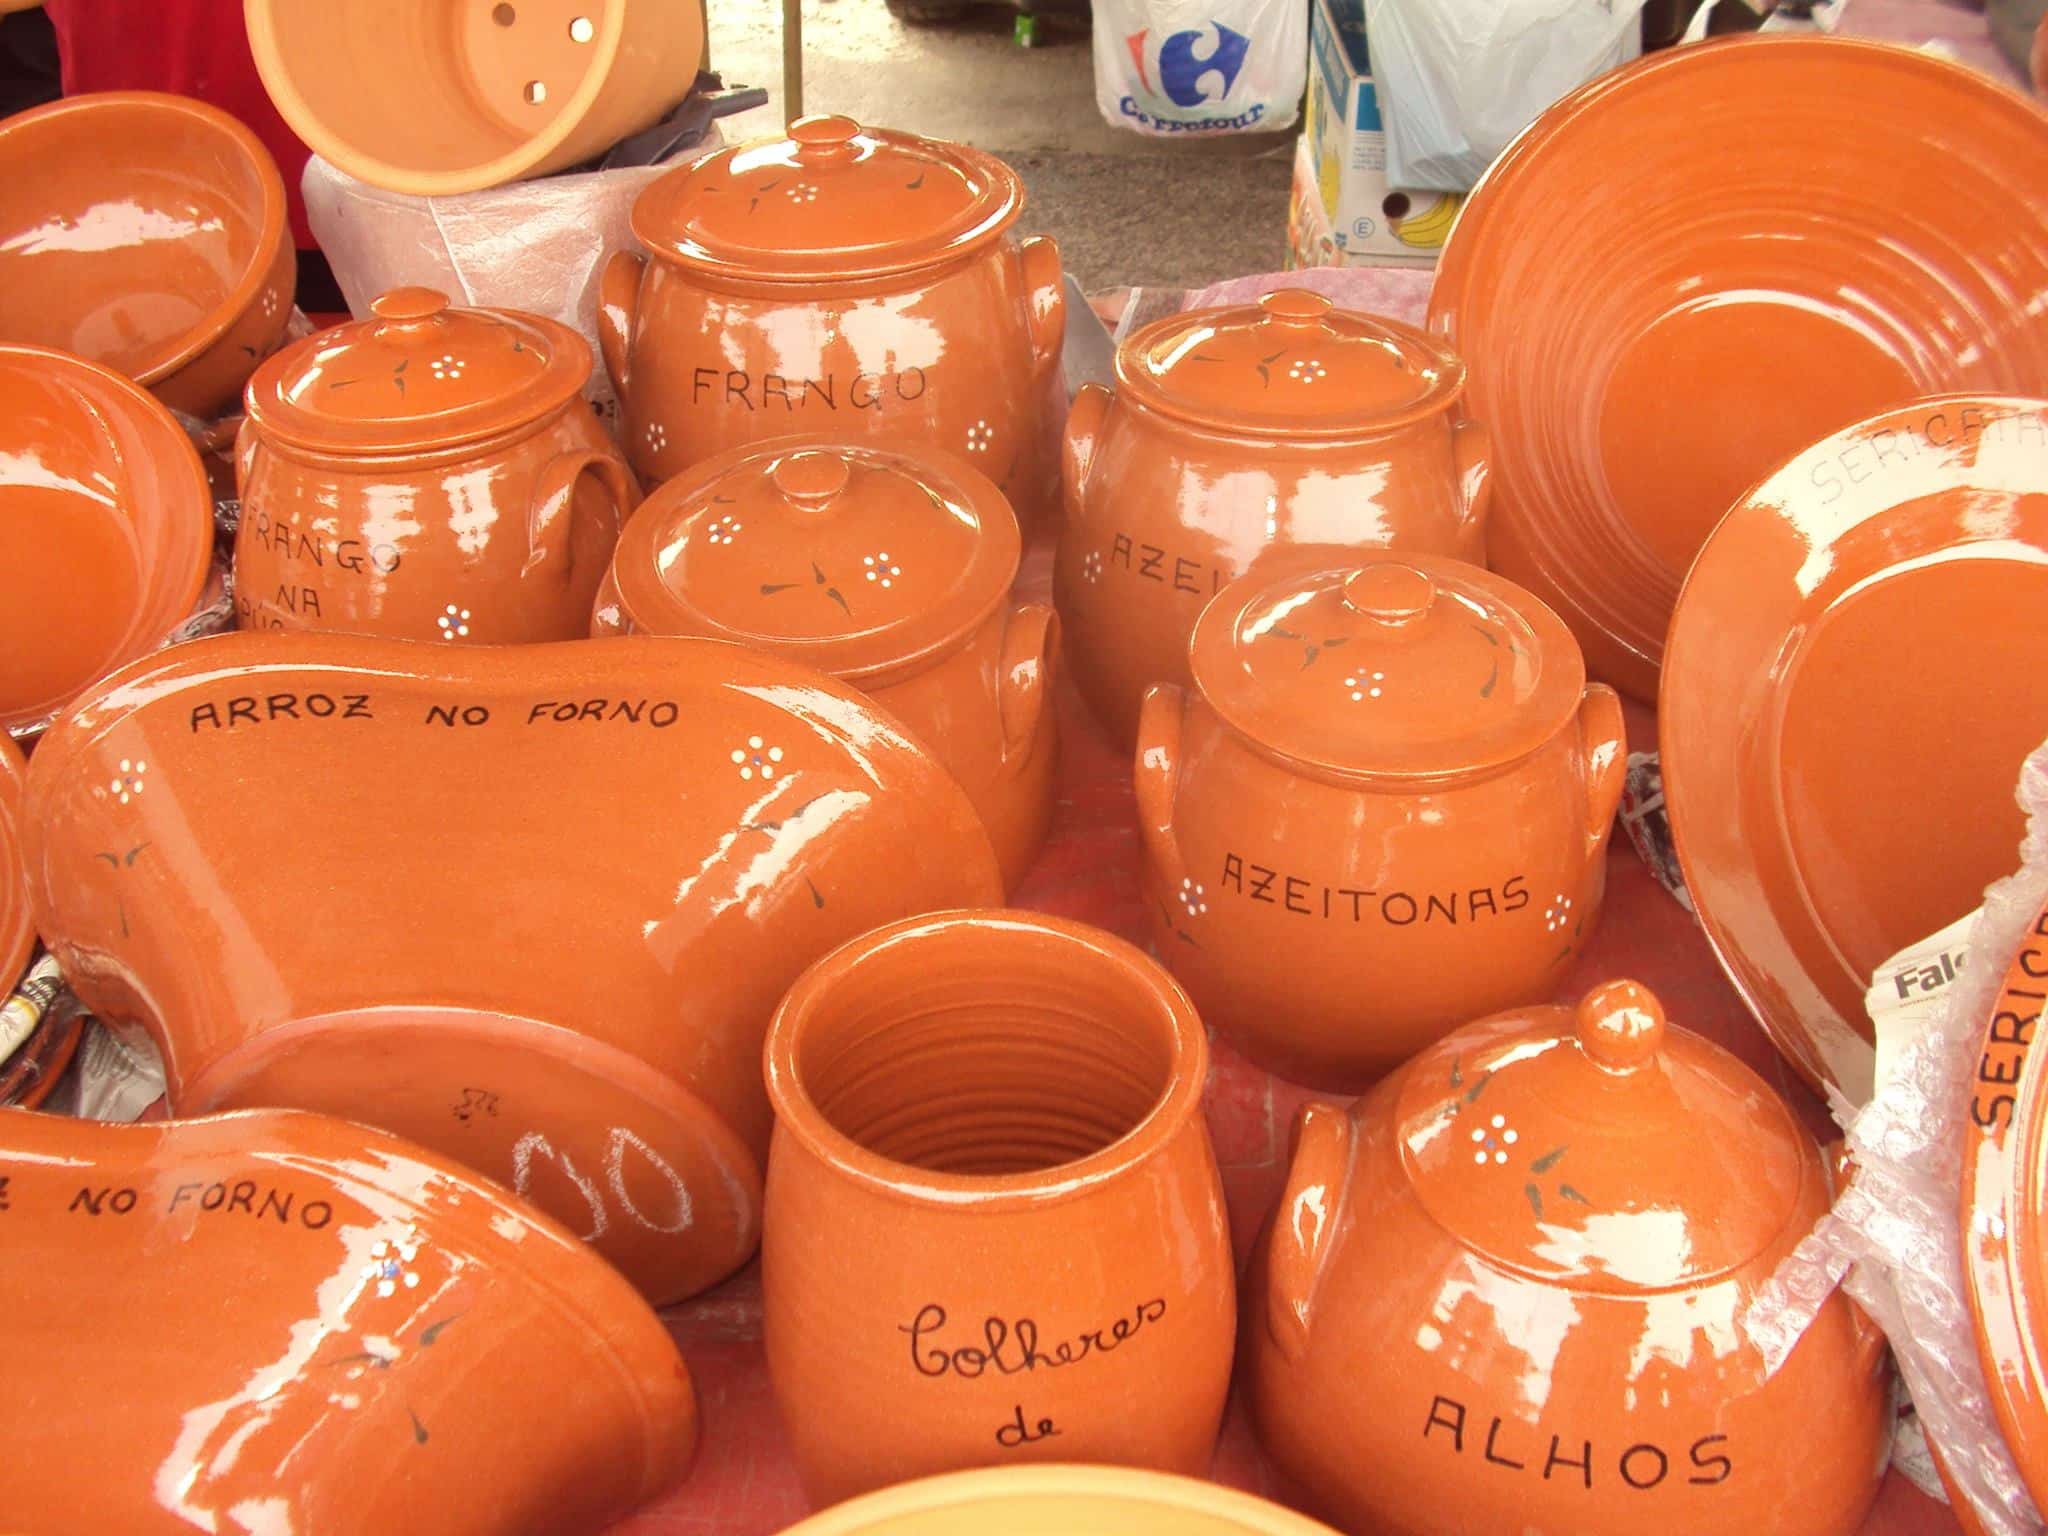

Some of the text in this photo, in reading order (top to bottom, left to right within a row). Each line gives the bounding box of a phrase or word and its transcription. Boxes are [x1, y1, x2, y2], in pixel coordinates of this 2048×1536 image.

[694, 367, 925, 411] FRANGO
[1111, 532, 1219, 596] AZEI
[276, 584, 321, 617] NA
[190, 693, 679, 733] ARROZ NO FORNO
[1222, 852, 1530, 925] AZEITONAS
[68, 1180, 333, 1229] NO FORNO
[898, 1298, 1166, 1378] Colheres
[996, 1404, 1062, 1448] de
[1424, 1395, 1732, 1489] ALHOS
